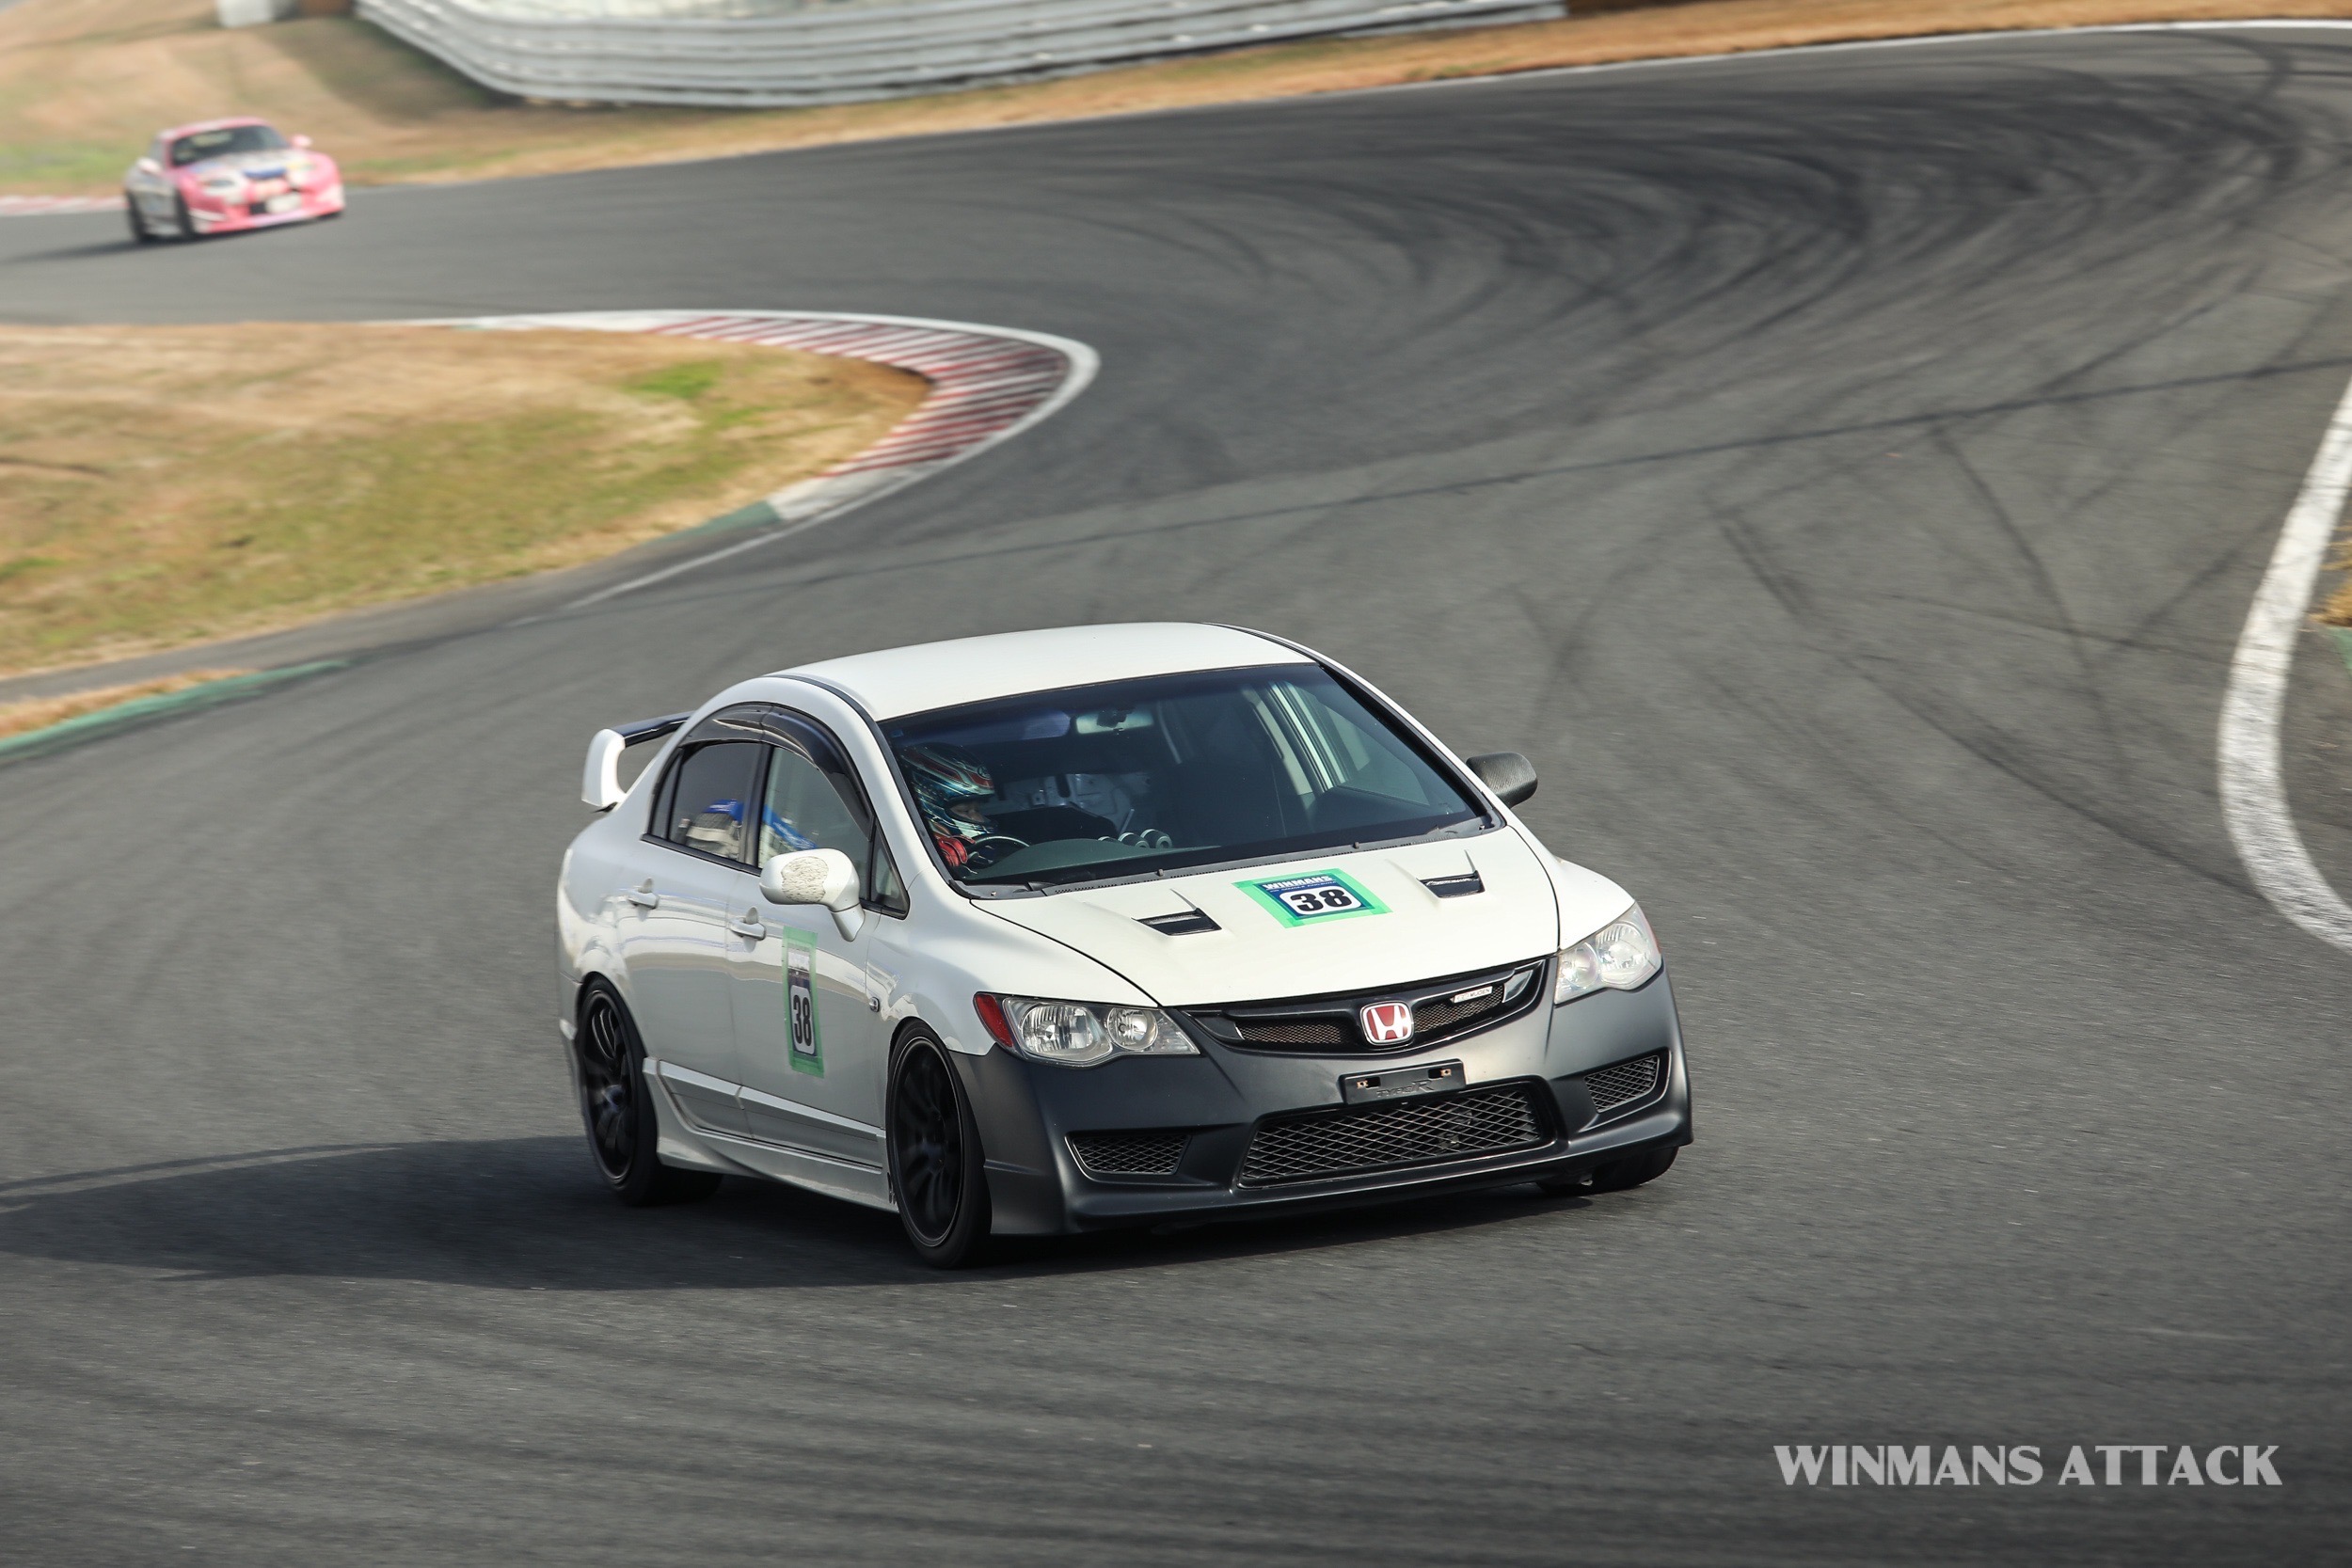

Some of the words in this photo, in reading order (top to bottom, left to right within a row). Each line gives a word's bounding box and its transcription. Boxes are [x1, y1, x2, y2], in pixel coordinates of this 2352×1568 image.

[1262, 876, 1333, 890] WINMANS
[1290, 889, 1352, 911] 38
[793, 994, 812, 1046] 38
